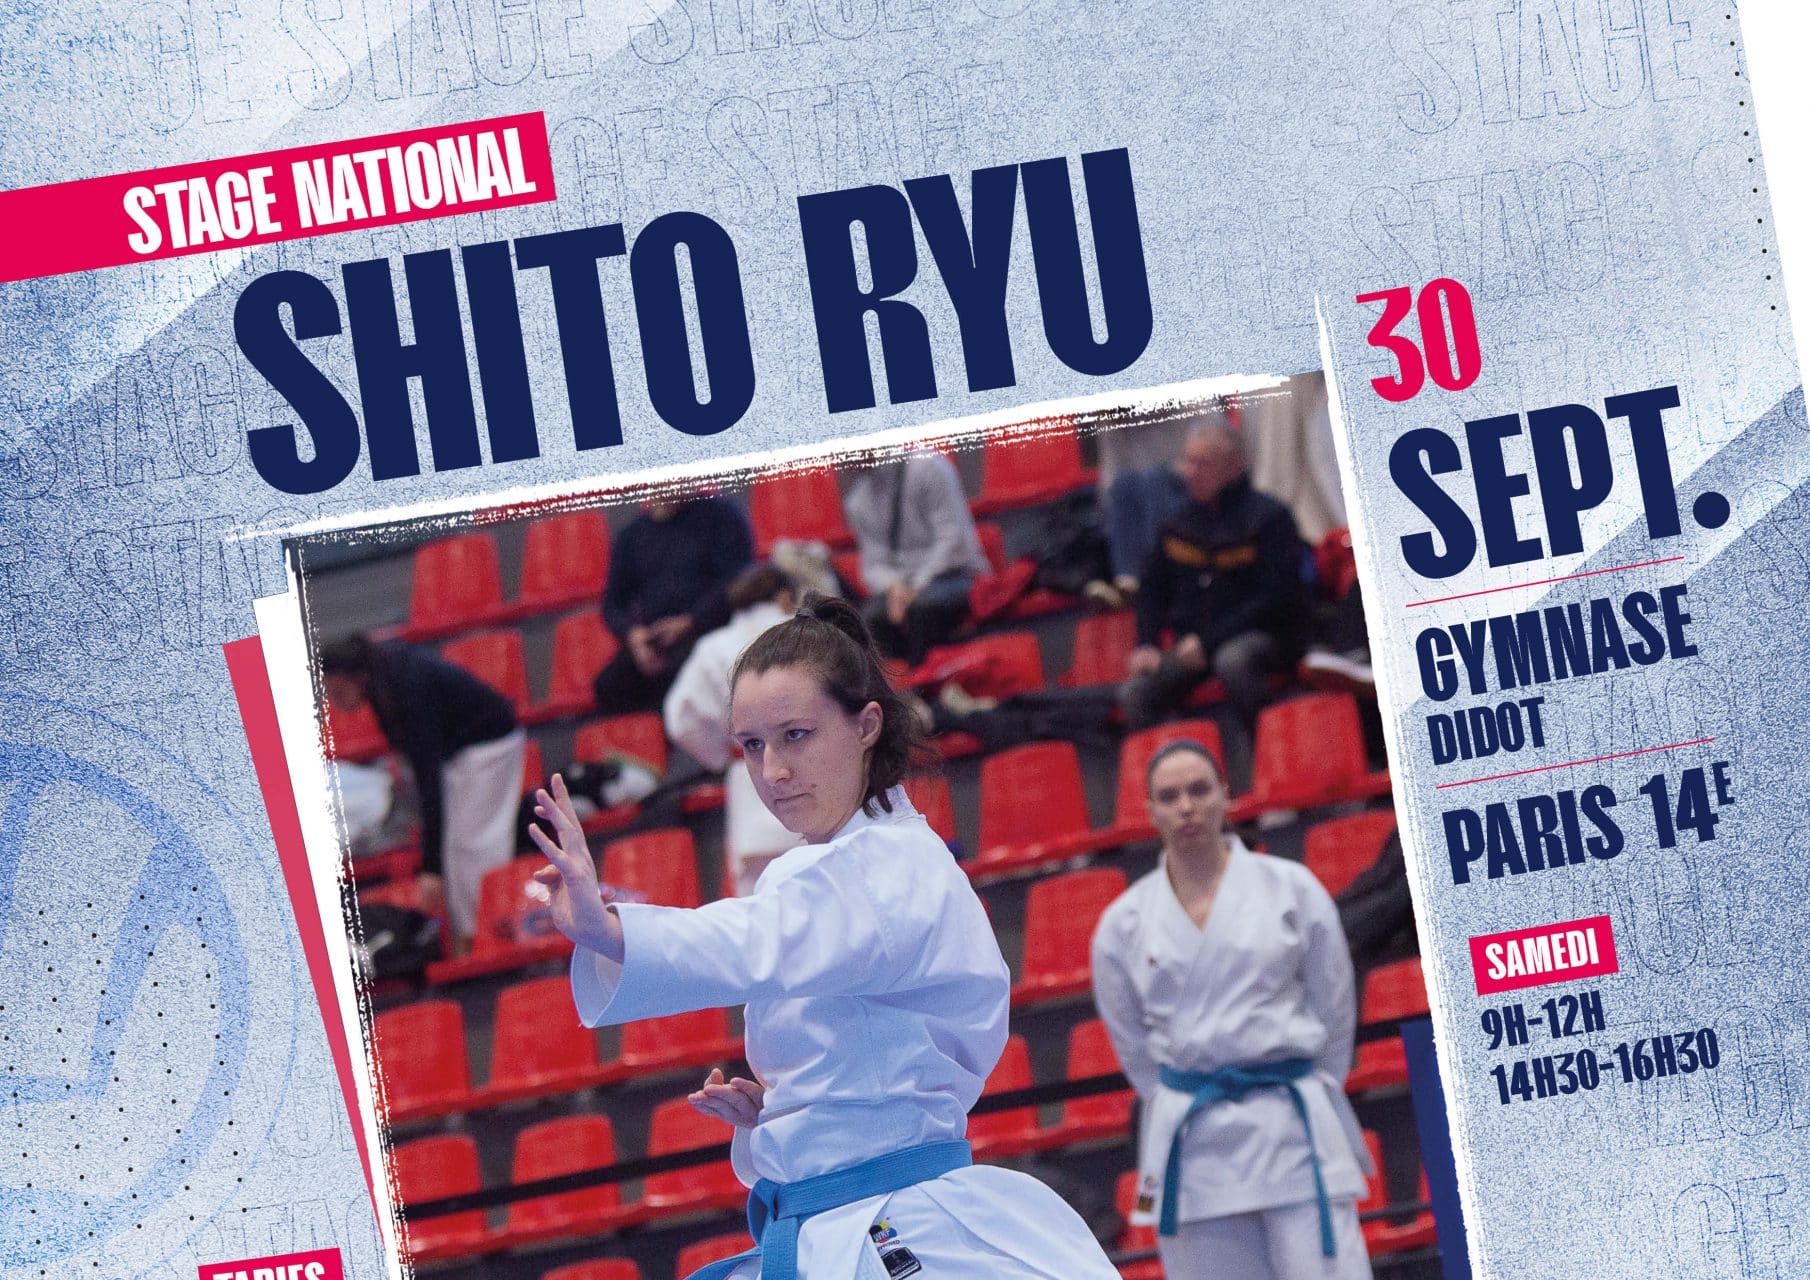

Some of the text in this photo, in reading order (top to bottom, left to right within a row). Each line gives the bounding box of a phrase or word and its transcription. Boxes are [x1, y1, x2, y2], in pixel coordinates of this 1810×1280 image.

[124, 167, 282, 255] STAGE
[292, 128, 536, 229] NATIONAL
[234, 211, 756, 495] SHITO
[797, 147, 1154, 414] RYU
[1356, 278, 1482, 402] 30
[1389, 386, 1731, 579] SEPT.
[1415, 584, 1699, 701] GYMNASE
[1427, 696, 1545, 766] DIDOT
[1442, 785, 1625, 886] PARIS
[1485, 928, 1599, 980] SAMEDI
[1481, 990, 1606, 1050] 9H-12H
[1490, 1027, 1720, 1104] 14H30-16H30
